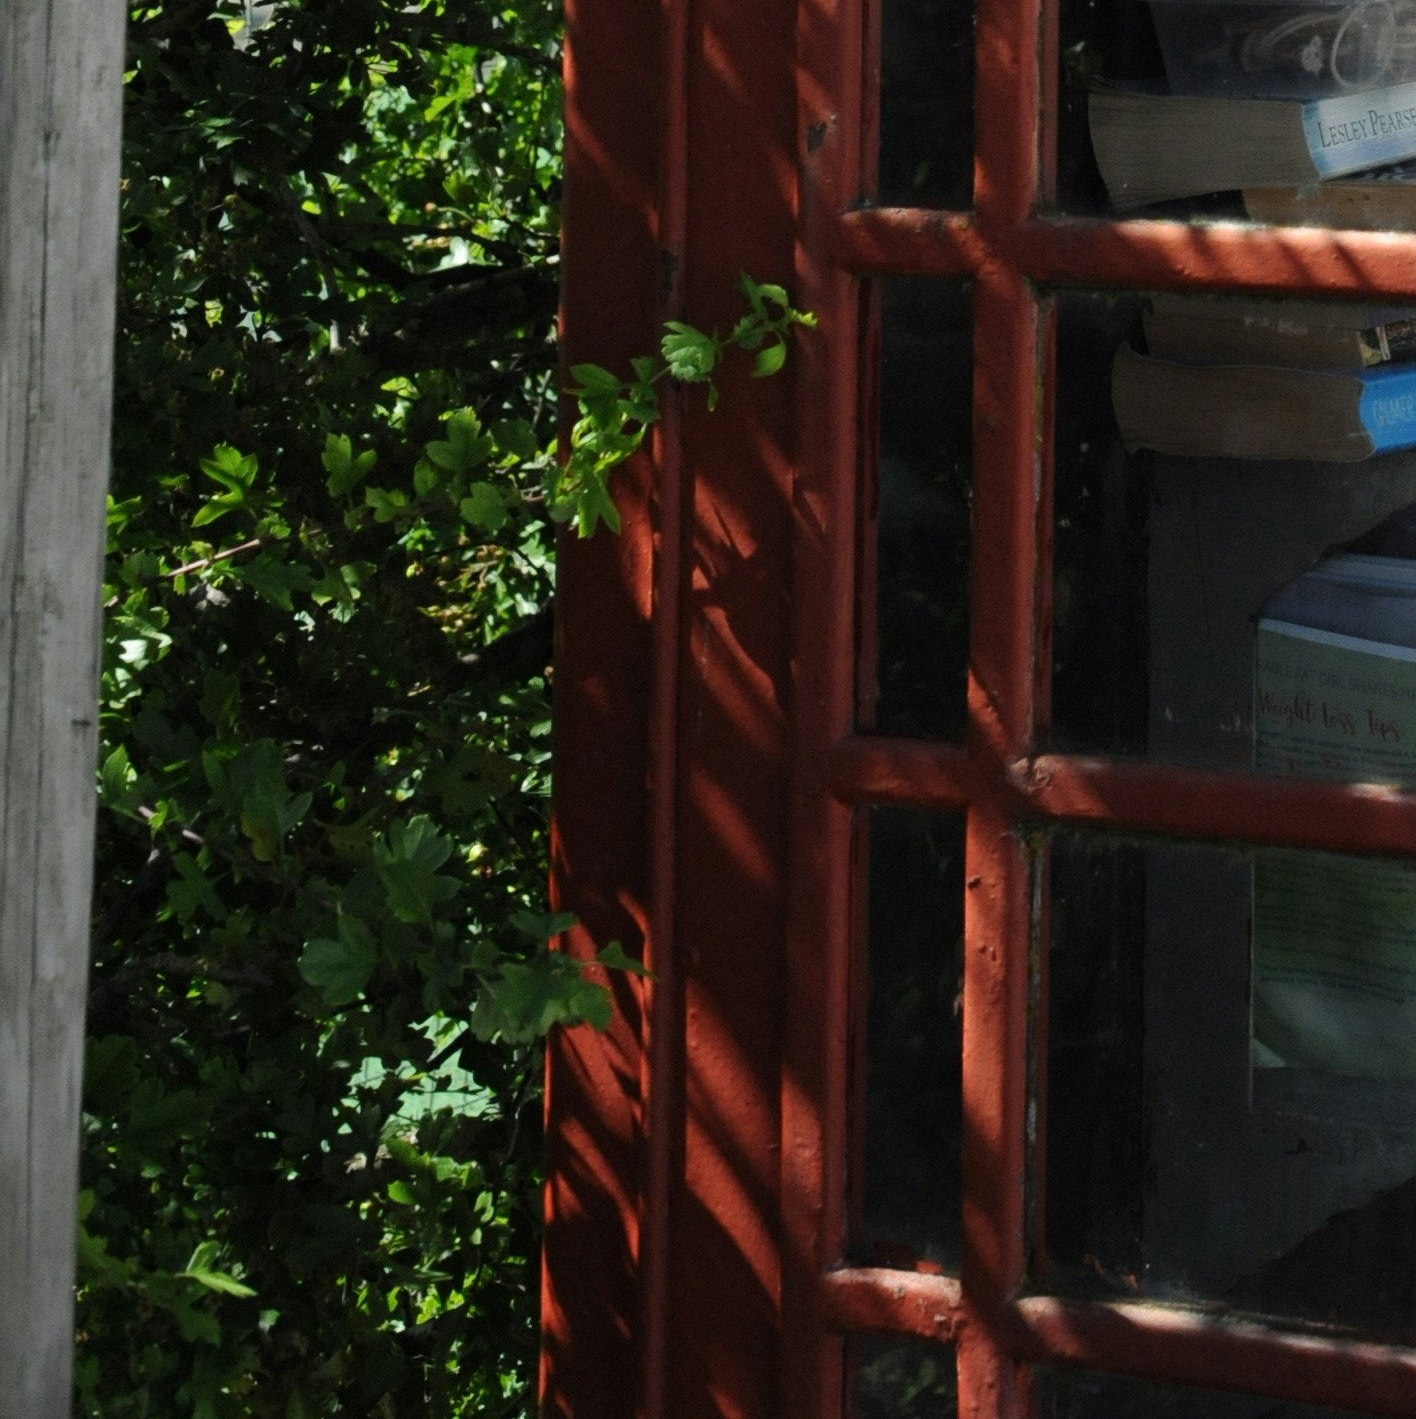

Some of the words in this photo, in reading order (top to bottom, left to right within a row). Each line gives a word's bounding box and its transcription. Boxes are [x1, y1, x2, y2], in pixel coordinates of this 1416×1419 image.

[1317, 119, 1368, 148] LESLEY
[1257, 687, 1315, 730] Weight
[1321, 701, 1357, 737] Loss
[1365, 707, 1401, 743] Tips
